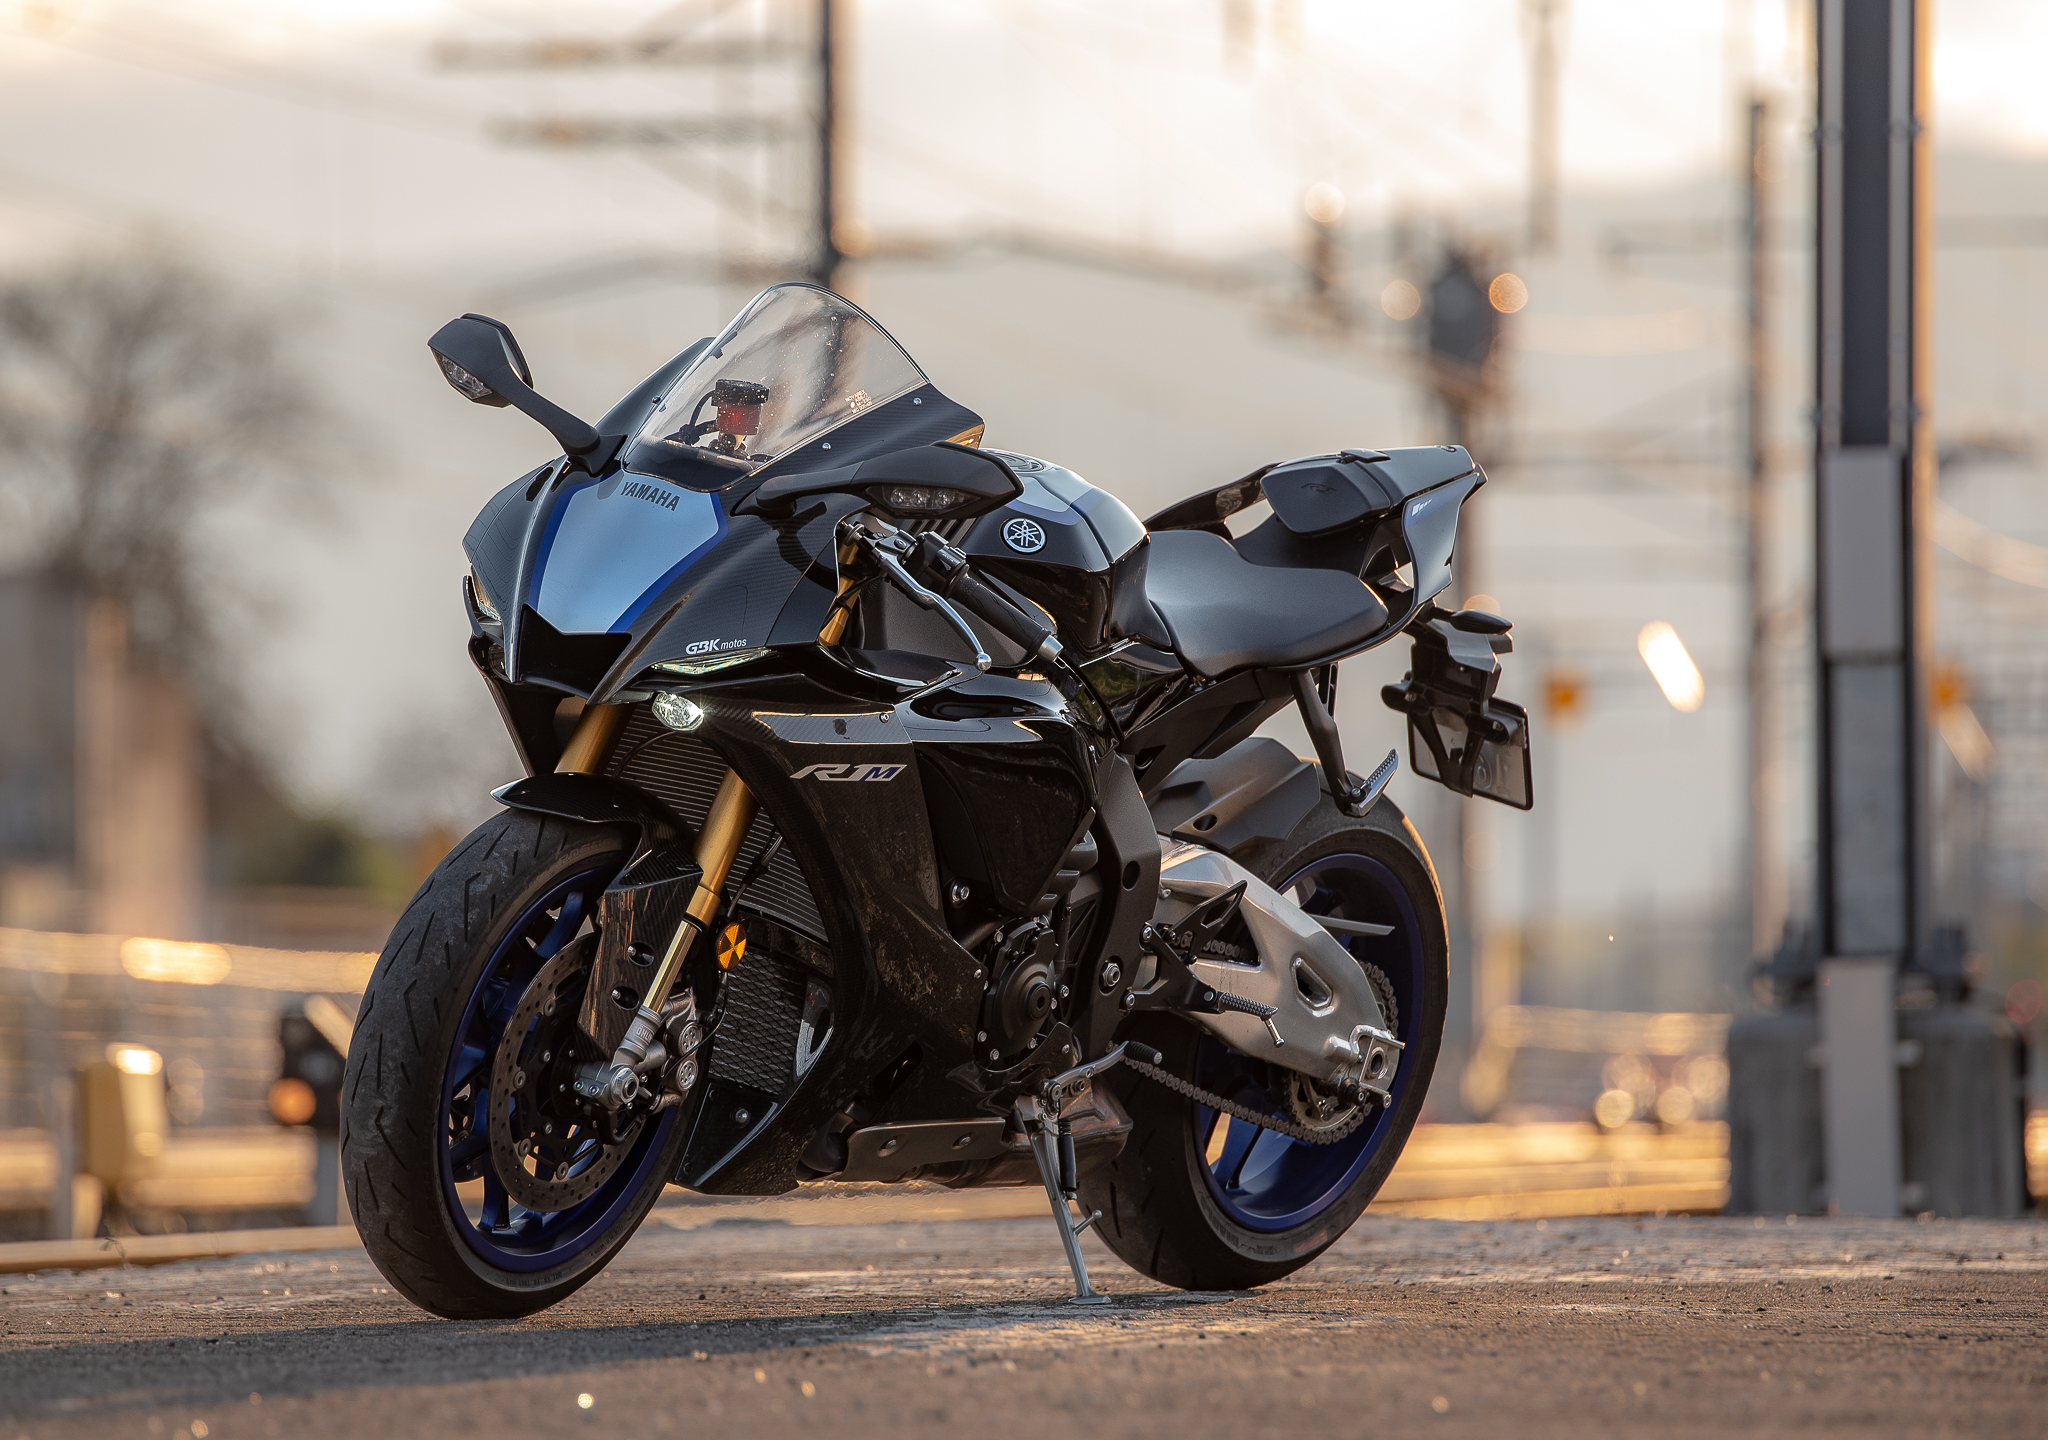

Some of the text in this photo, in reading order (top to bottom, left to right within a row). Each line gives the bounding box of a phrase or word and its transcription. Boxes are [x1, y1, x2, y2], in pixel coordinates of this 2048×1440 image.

[620, 481, 680, 512] YAMAHA
[685, 638, 747, 655] GBK motos
